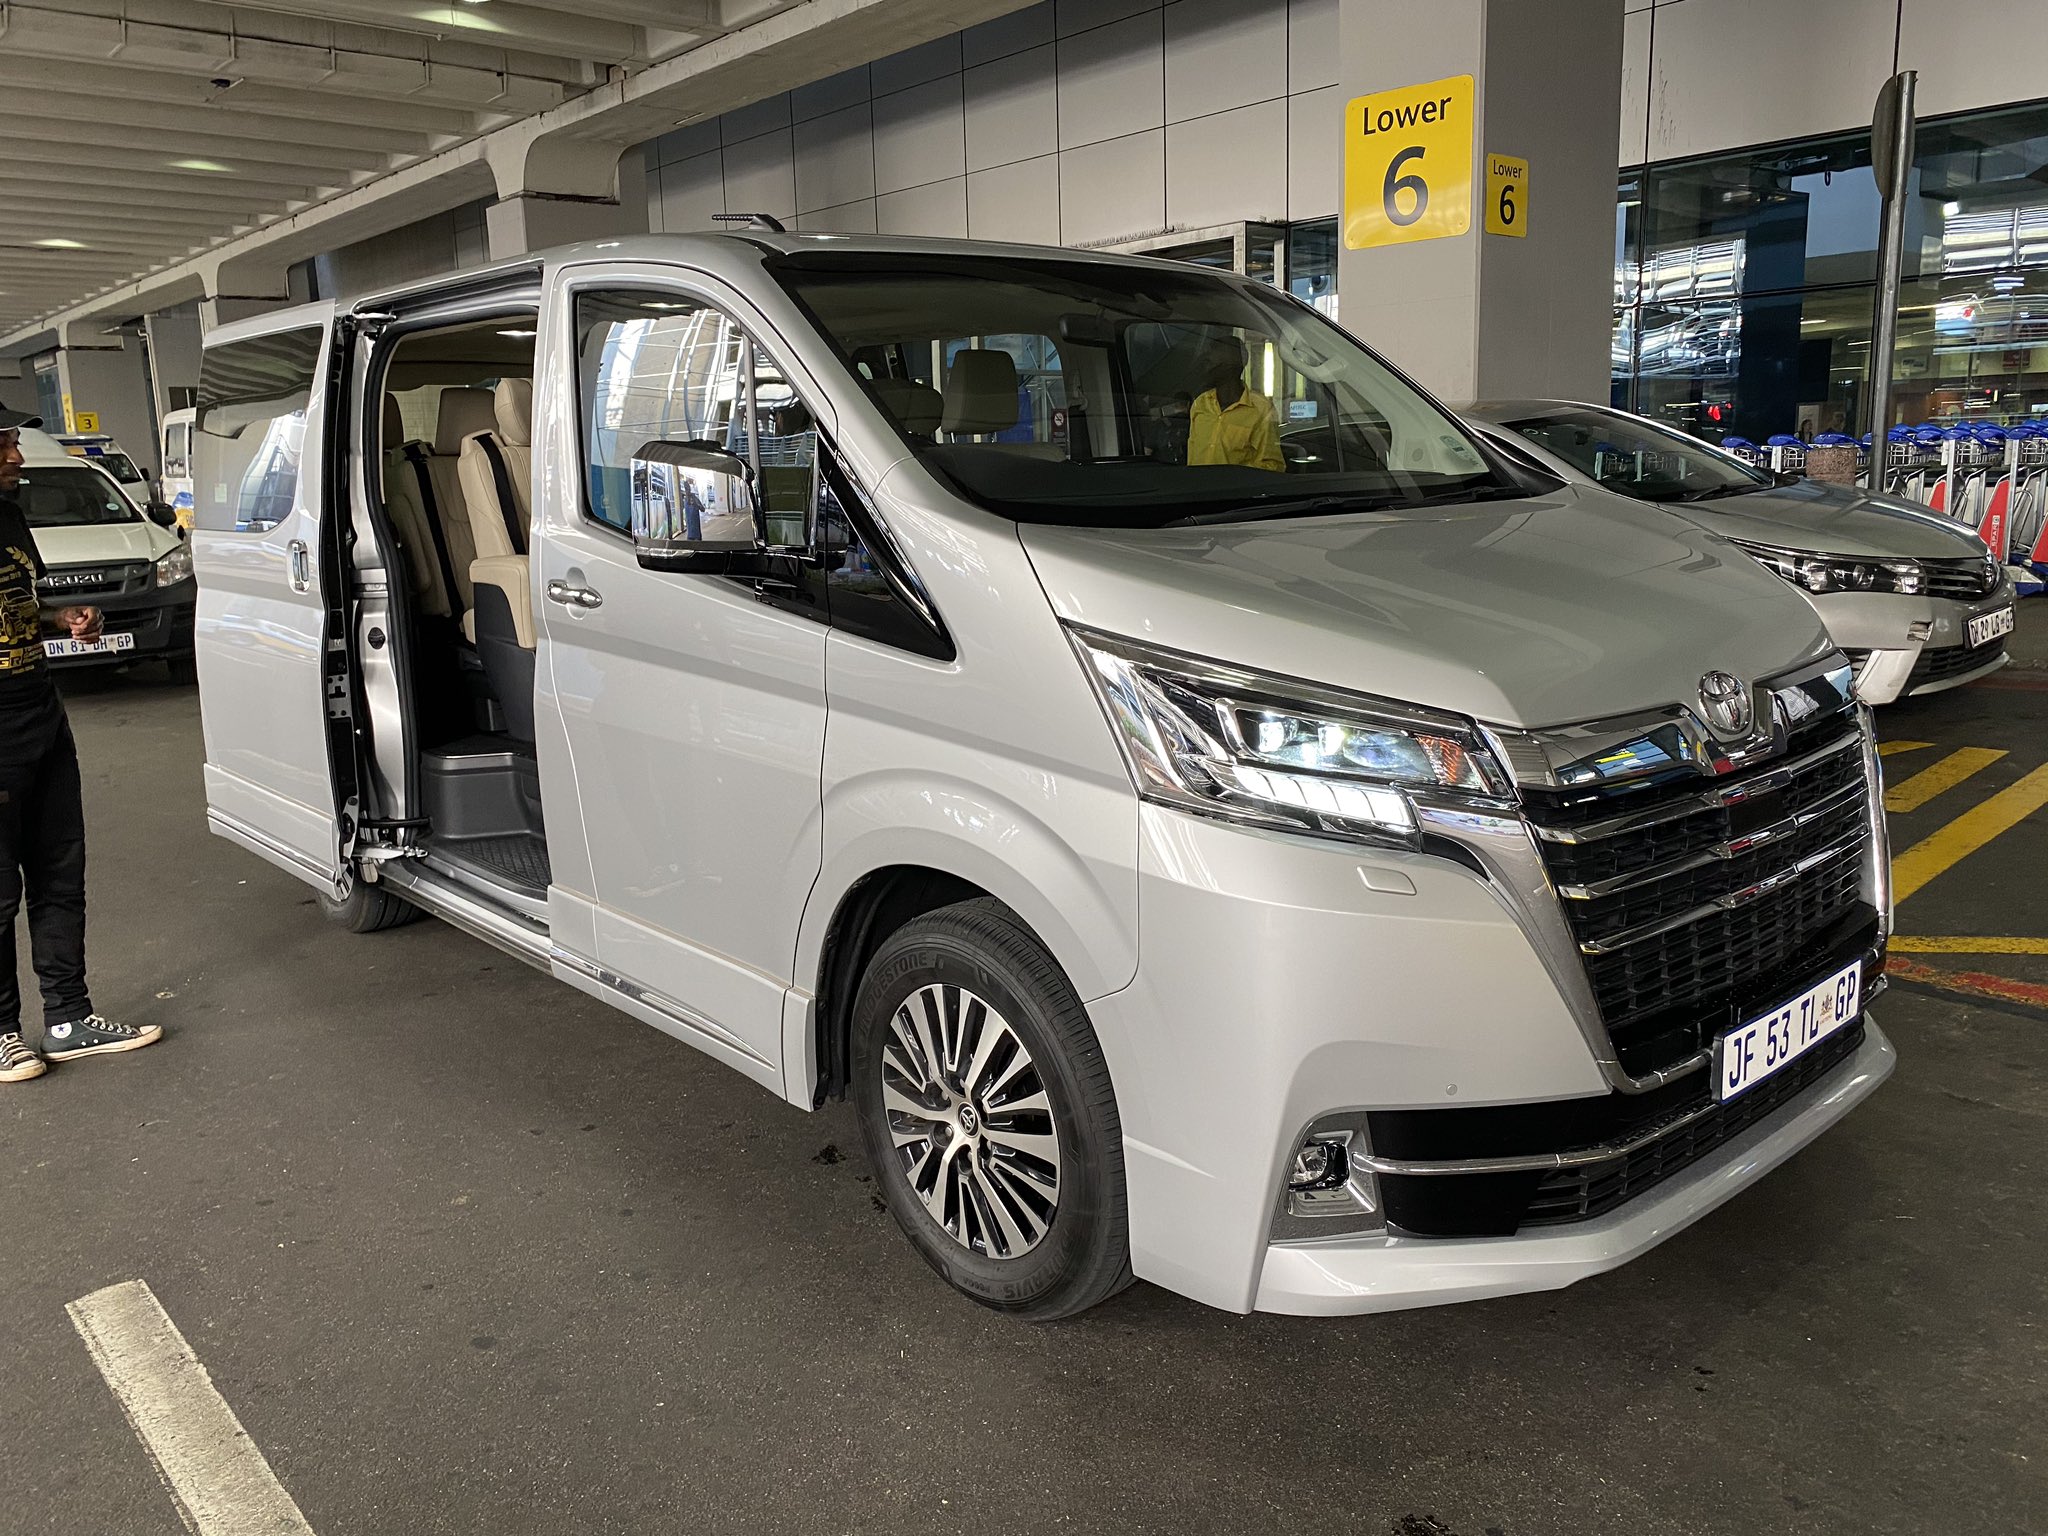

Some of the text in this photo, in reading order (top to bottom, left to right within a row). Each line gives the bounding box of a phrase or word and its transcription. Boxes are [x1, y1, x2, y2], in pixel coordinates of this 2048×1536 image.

[1363, 97, 1452, 135] Lower
[1493, 160, 1522, 179] Lower
[1383, 146, 1429, 226] 6
[1500, 185, 1515, 225] 6
[83, 418, 92, 429] 3
[48, 574, 104, 587] ISUZU
[48, 641, 64, 655] DN
[71, 640, 86, 653] 81
[117, 635, 131, 648] GP
[1729, 970, 1856, 1088] JF 53 TL GP
